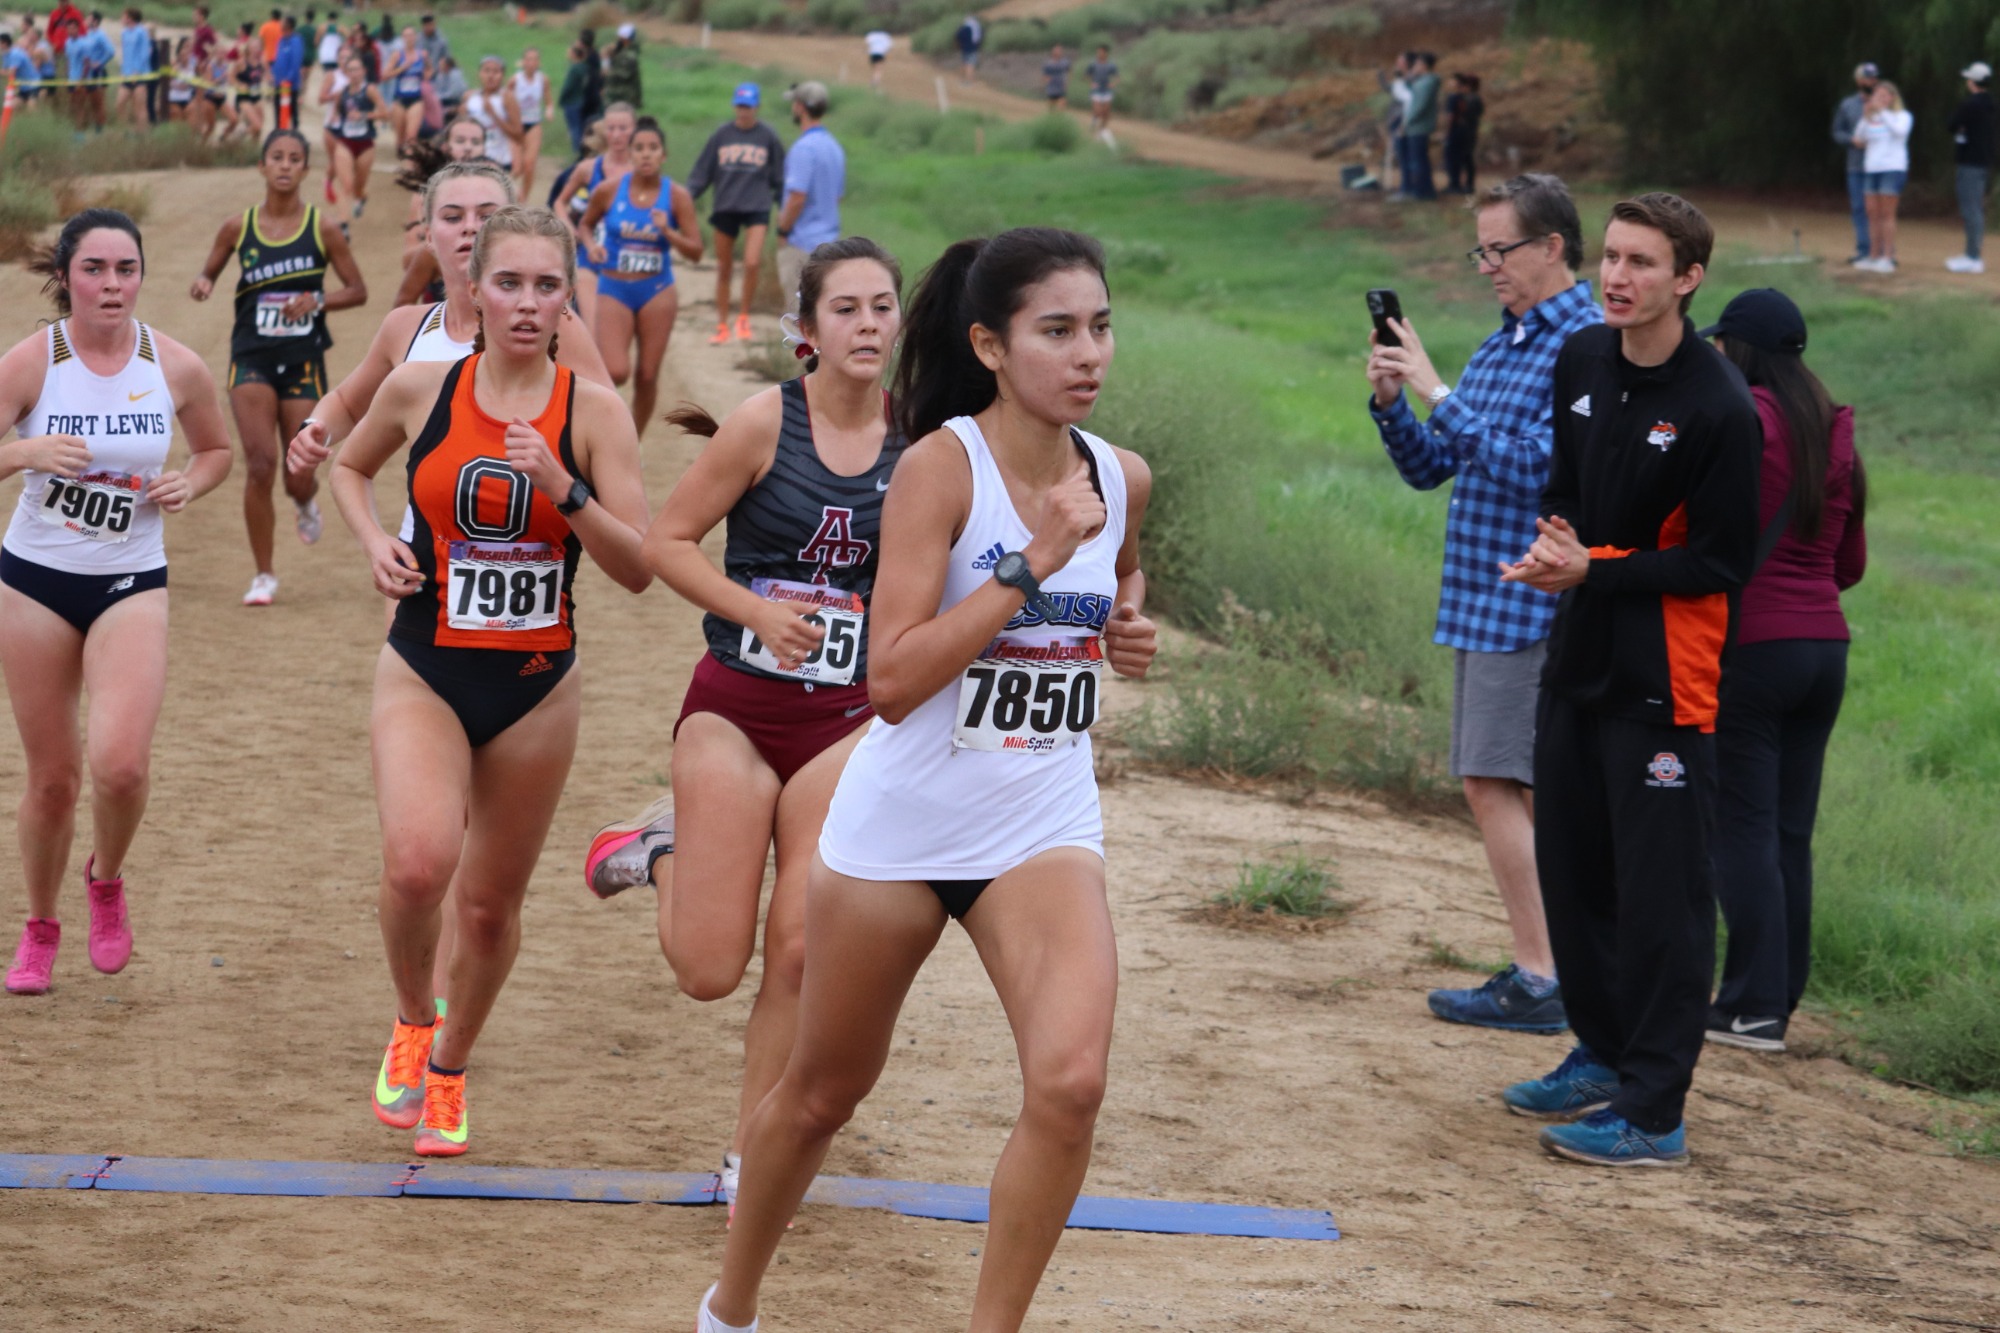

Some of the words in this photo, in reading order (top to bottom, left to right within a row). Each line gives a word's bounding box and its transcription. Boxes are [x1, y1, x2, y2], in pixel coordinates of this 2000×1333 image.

[46, 414, 99, 436] FORT
[105, 413, 165, 435] LEWIS
[44, 478, 134, 533] 7905
[64, 520, 99, 538] MileSplit
[971, 558, 998, 571] adi
[453, 568, 559, 618] 7981
[1003, 592, 1113, 632] SUSB
[484, 617, 526, 630] MileSplit
[518, 662, 553, 677] adidas
[963, 667, 1096, 734] 7850
[1002, 736, 1055, 752] MileSplit
